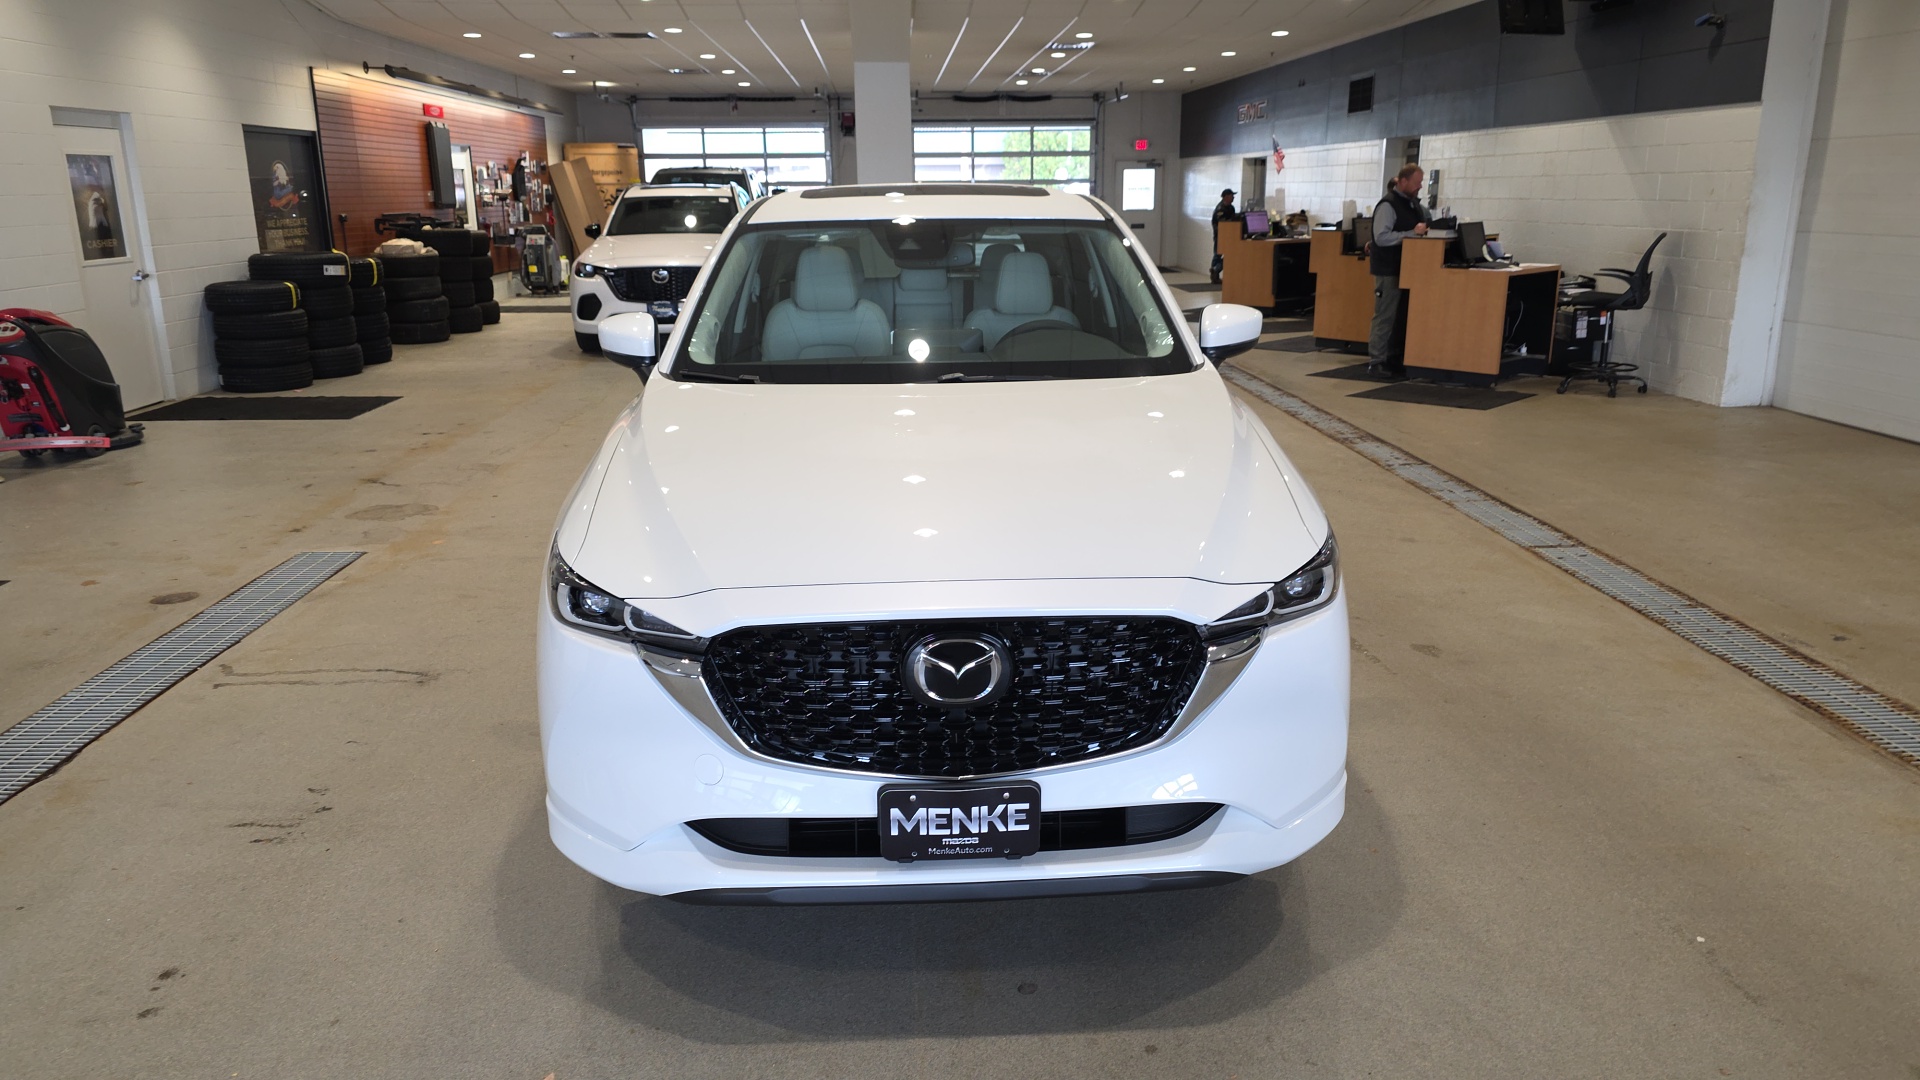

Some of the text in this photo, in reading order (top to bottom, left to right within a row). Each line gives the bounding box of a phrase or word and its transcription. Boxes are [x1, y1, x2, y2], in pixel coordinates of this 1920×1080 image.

[1238, 100, 1267, 124] GMC
[267, 218, 308, 228] WE APPRECIATE
[268, 230, 283, 238] YOUR
[87, 239, 117, 248] CASHIER
[275, 239, 292, 248] THANK
[890, 803, 1030, 836] MENKE
[928, 846, 993, 855] MenkeAuto.com
